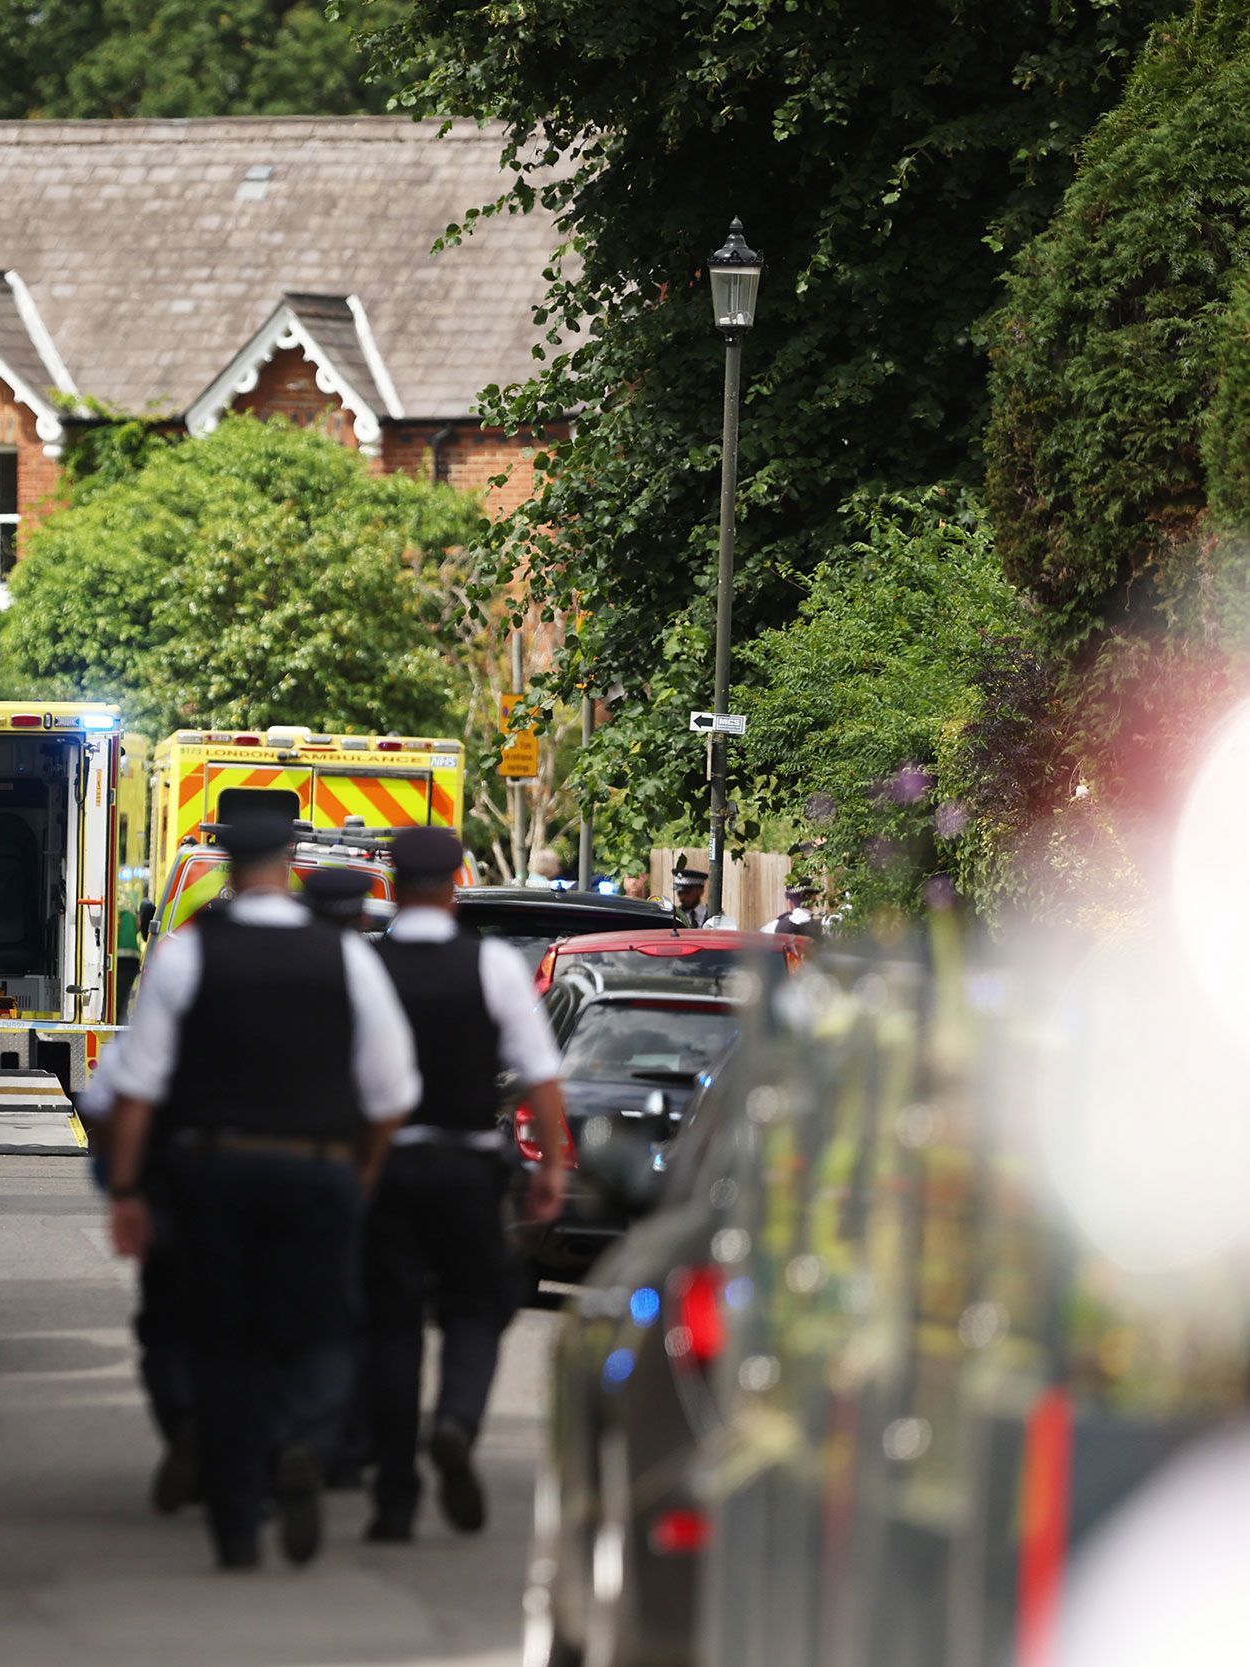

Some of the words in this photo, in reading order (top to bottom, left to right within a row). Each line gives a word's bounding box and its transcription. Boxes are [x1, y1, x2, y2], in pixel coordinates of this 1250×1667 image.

[205, 749, 275, 759] LONDON
[297, 752, 424, 764] AMBULANCE
[431, 756, 457, 767] NHS
